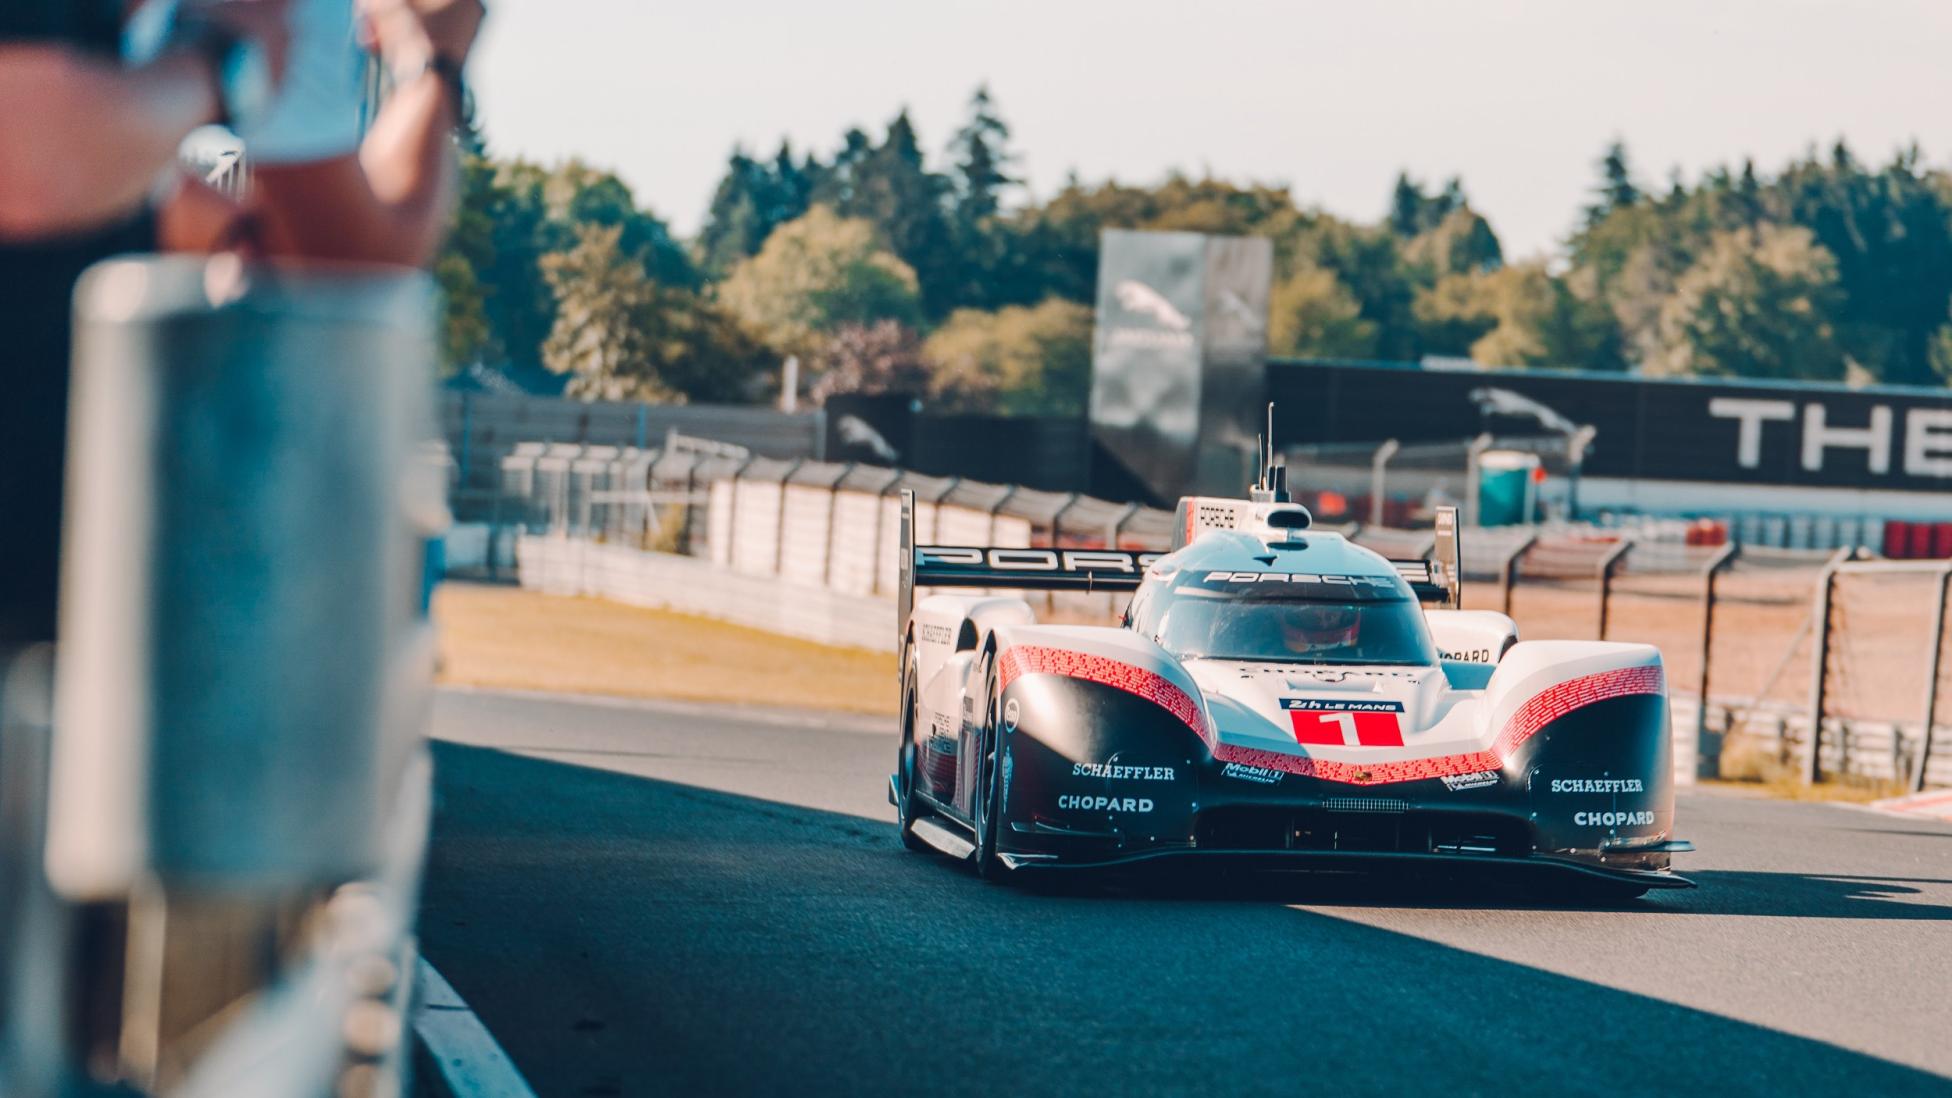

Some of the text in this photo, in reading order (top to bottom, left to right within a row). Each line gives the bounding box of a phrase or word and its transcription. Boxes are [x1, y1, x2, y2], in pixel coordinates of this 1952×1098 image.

[1203, 571, 1395, 588] PORSCHE
[1325, 703, 1345, 711] LE
[1348, 704, 1397, 712] MANS
[1318, 712, 1361, 746] 1
[1072, 762, 1175, 781] SCHAEFFLER
[1225, 762, 1269, 777] Mobil
[1551, 779, 1643, 793] SCHAEFFLER
[1058, 795, 1154, 813] CHOPARD
[1574, 811, 1655, 826] CHOPARD
